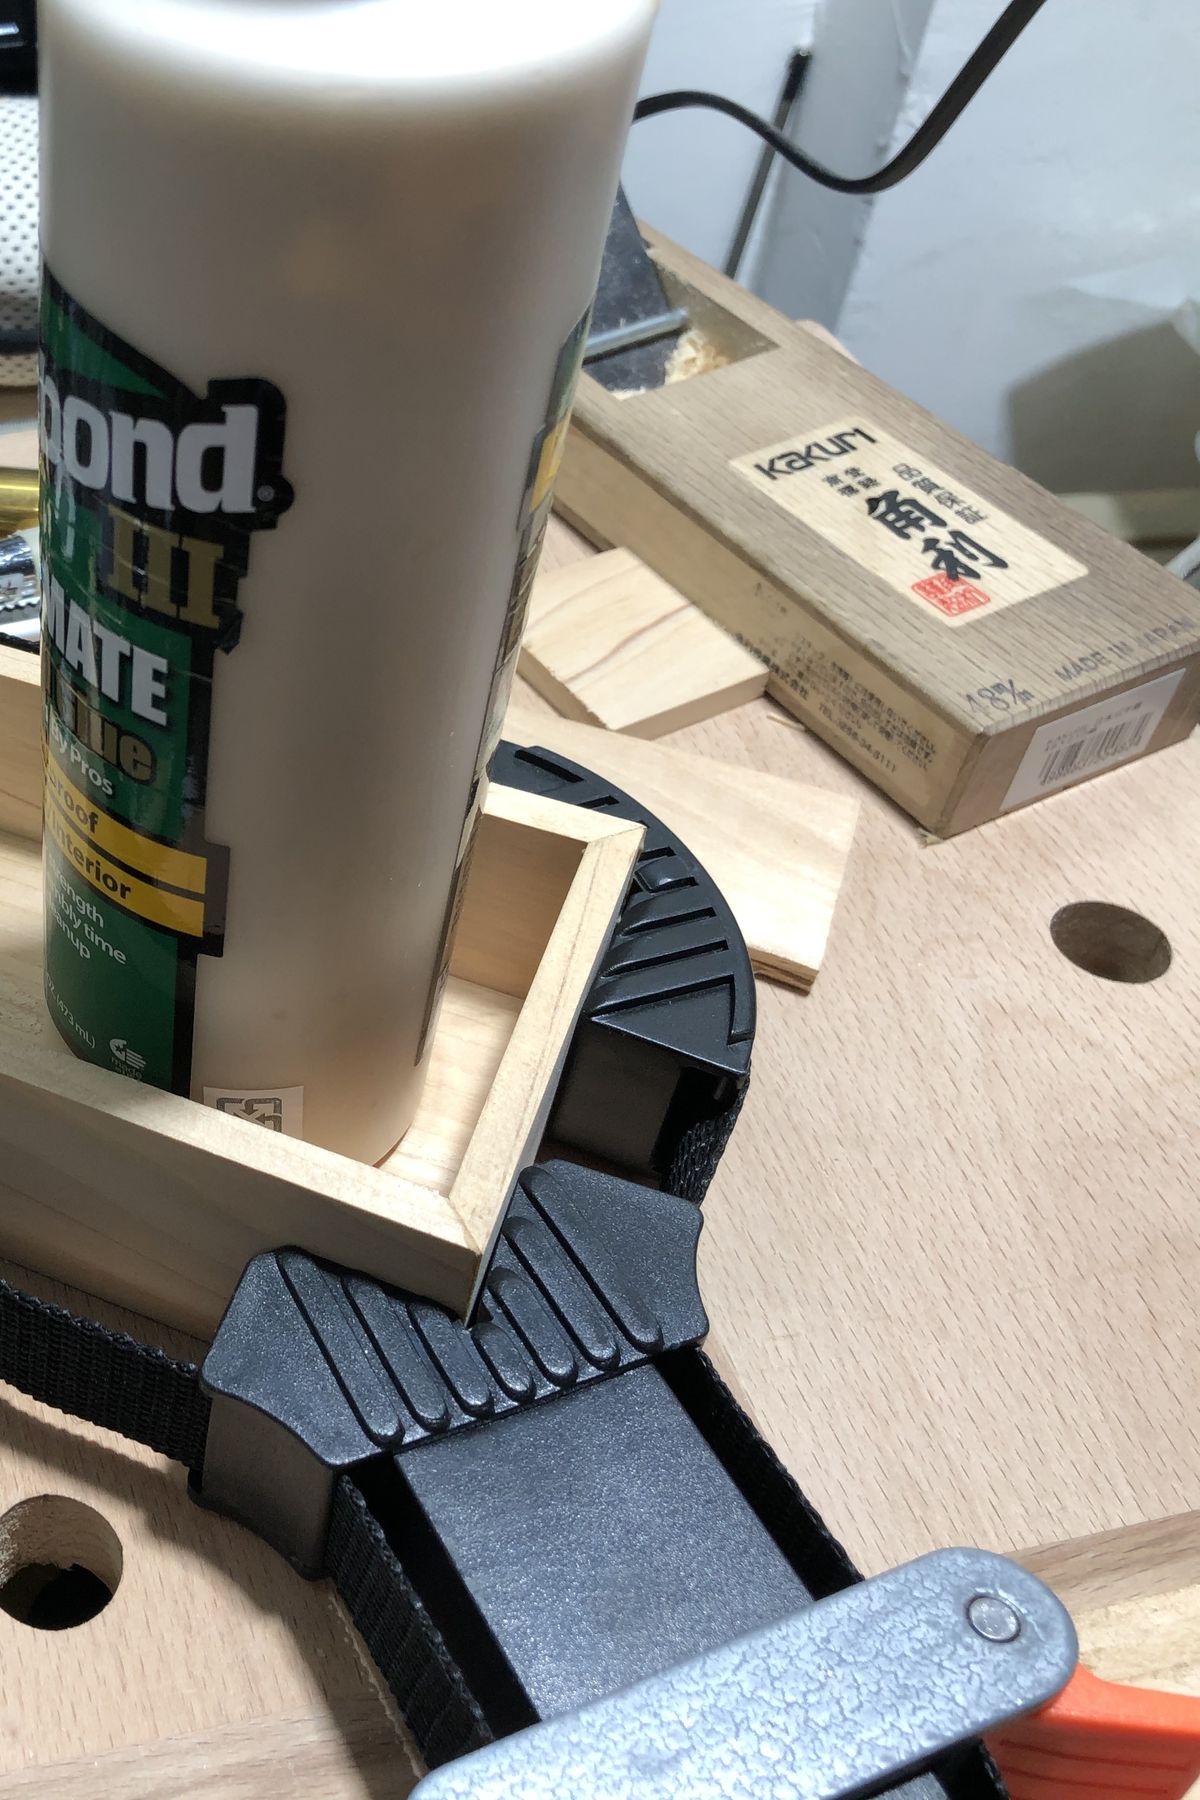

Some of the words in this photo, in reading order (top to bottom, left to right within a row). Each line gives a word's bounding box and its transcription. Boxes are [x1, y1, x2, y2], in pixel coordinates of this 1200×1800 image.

[865, 490, 1009, 580] 角利
[1055, 650, 1112, 683] MADE
[70, 744, 113, 796] Pros
[83, 923, 127, 965] time
